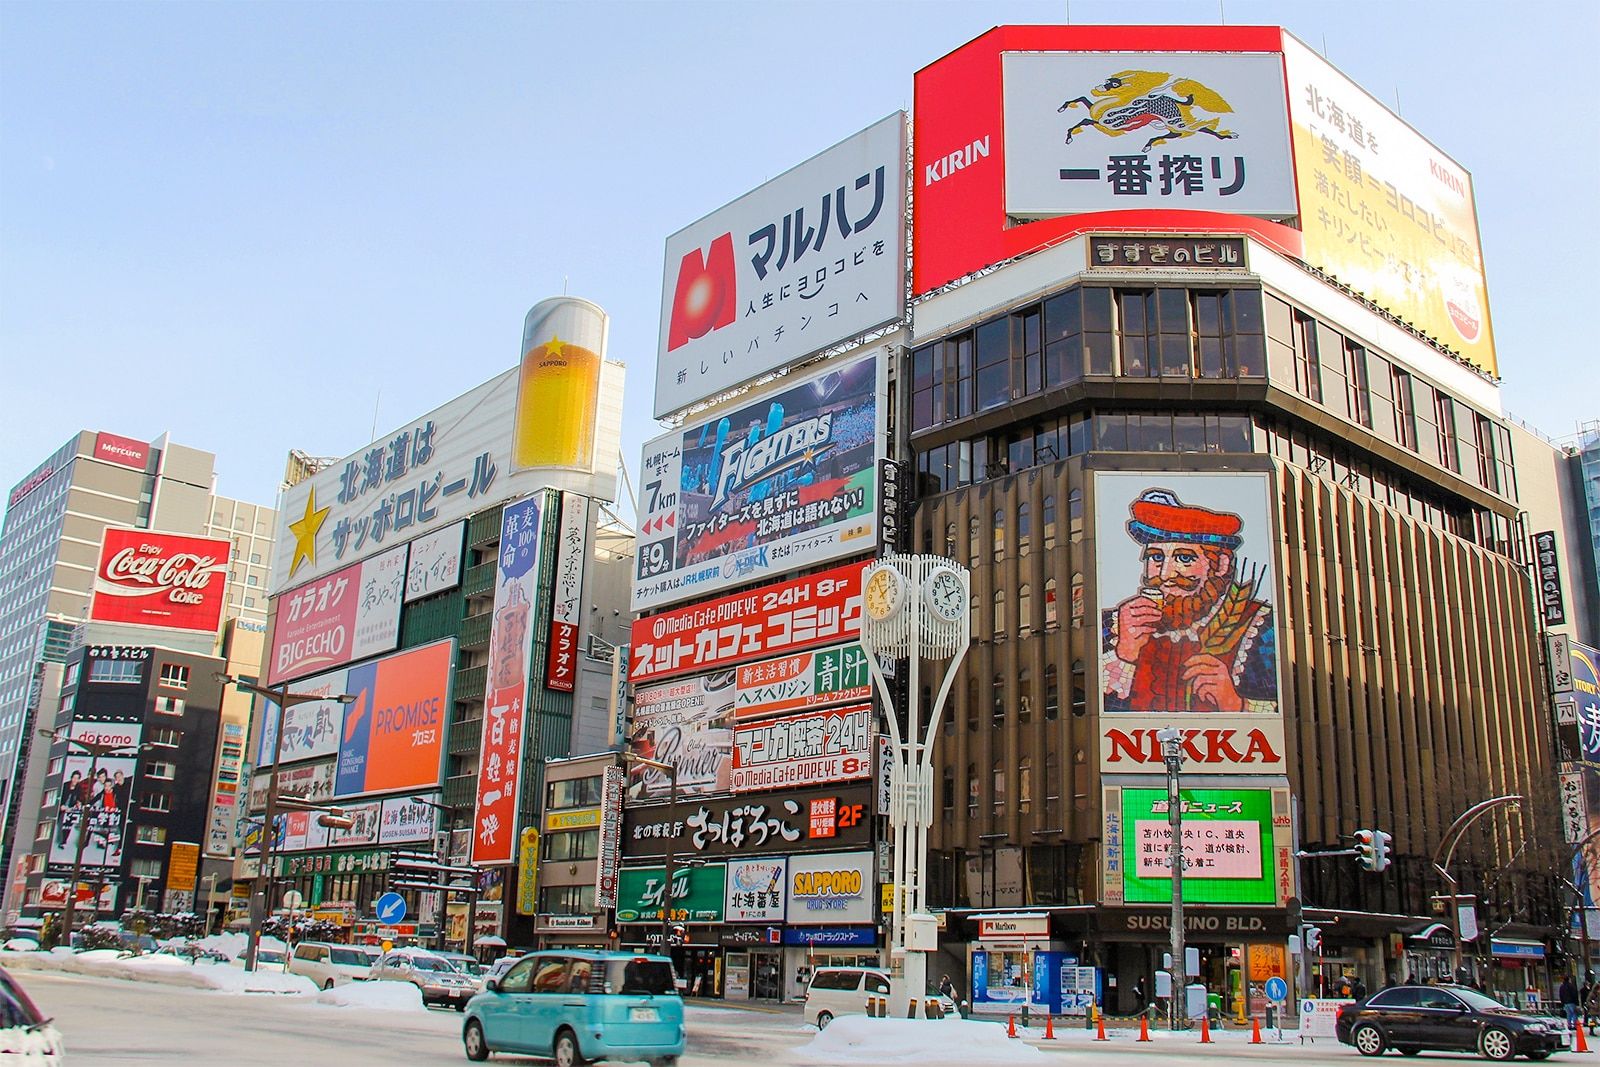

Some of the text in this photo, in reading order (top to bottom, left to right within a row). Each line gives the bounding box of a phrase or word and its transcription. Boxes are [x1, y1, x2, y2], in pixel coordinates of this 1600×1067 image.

[1304, 83, 1380, 156] 北海道を
[925, 134, 990, 187] KIRIN
[1059, 154, 1247, 196] 一番搾り
[1428, 158, 1466, 199] KIRIN
[748, 164, 885, 282] マルハン
[745, 239, 885, 318] 人生にヨロコビを
[538, 359, 568, 368] SAPPORO
[101, 442, 142, 460] Mercure
[337, 420, 436, 505] 北海道は
[645, 446, 681, 470] 札幌ドーム
[655, 463, 670, 477] まで
[709, 411, 834, 513] FIGHTERS
[332, 452, 498, 561] サッポロビール
[645, 479, 677, 514] 7km
[686, 489, 800, 541] ファイターズを見ずに
[139, 543, 163, 556] Enjoy
[502, 513, 520, 570] 革命
[642, 545, 650, 577] 地下鉄
[771, 544, 791, 560] または
[794, 534, 834, 553] ファイターズ
[106, 547, 217, 590] Coca-Cola
[168, 587, 204, 605] Coke
[286, 577, 349, 624] カラオケ
[666, 579, 849, 633] Media Cafe POPEYE 24H 8F
[276, 639, 305, 674] BIG
[305, 624, 346, 657] ECHO
[555, 624, 573, 678] カラオケ
[738, 678, 812, 704] ヘスペリジン
[742, 649, 868, 692] 新生活習慣 青汁
[375, 696, 439, 736] PROMISE
[826, 711, 869, 754] 24H
[412, 729, 436, 748] プロミス
[503, 697, 520, 797] 本格麦焼酎
[1103, 727, 1282, 764] NIKKA
[745, 757, 868, 786] Media Cafe POPEYE 8F
[686, 800, 801, 850] さっぽろっこ
[838, 804, 864, 827] 2F
[1273, 815, 1291, 825] uhb
[1106, 812, 1121, 872] 北海道新聞
[793, 869, 863, 897] SAPPORO
[994, 922, 1017, 931] Marlboro
[1126, 915, 1267, 931] SUSUINO BLD.
